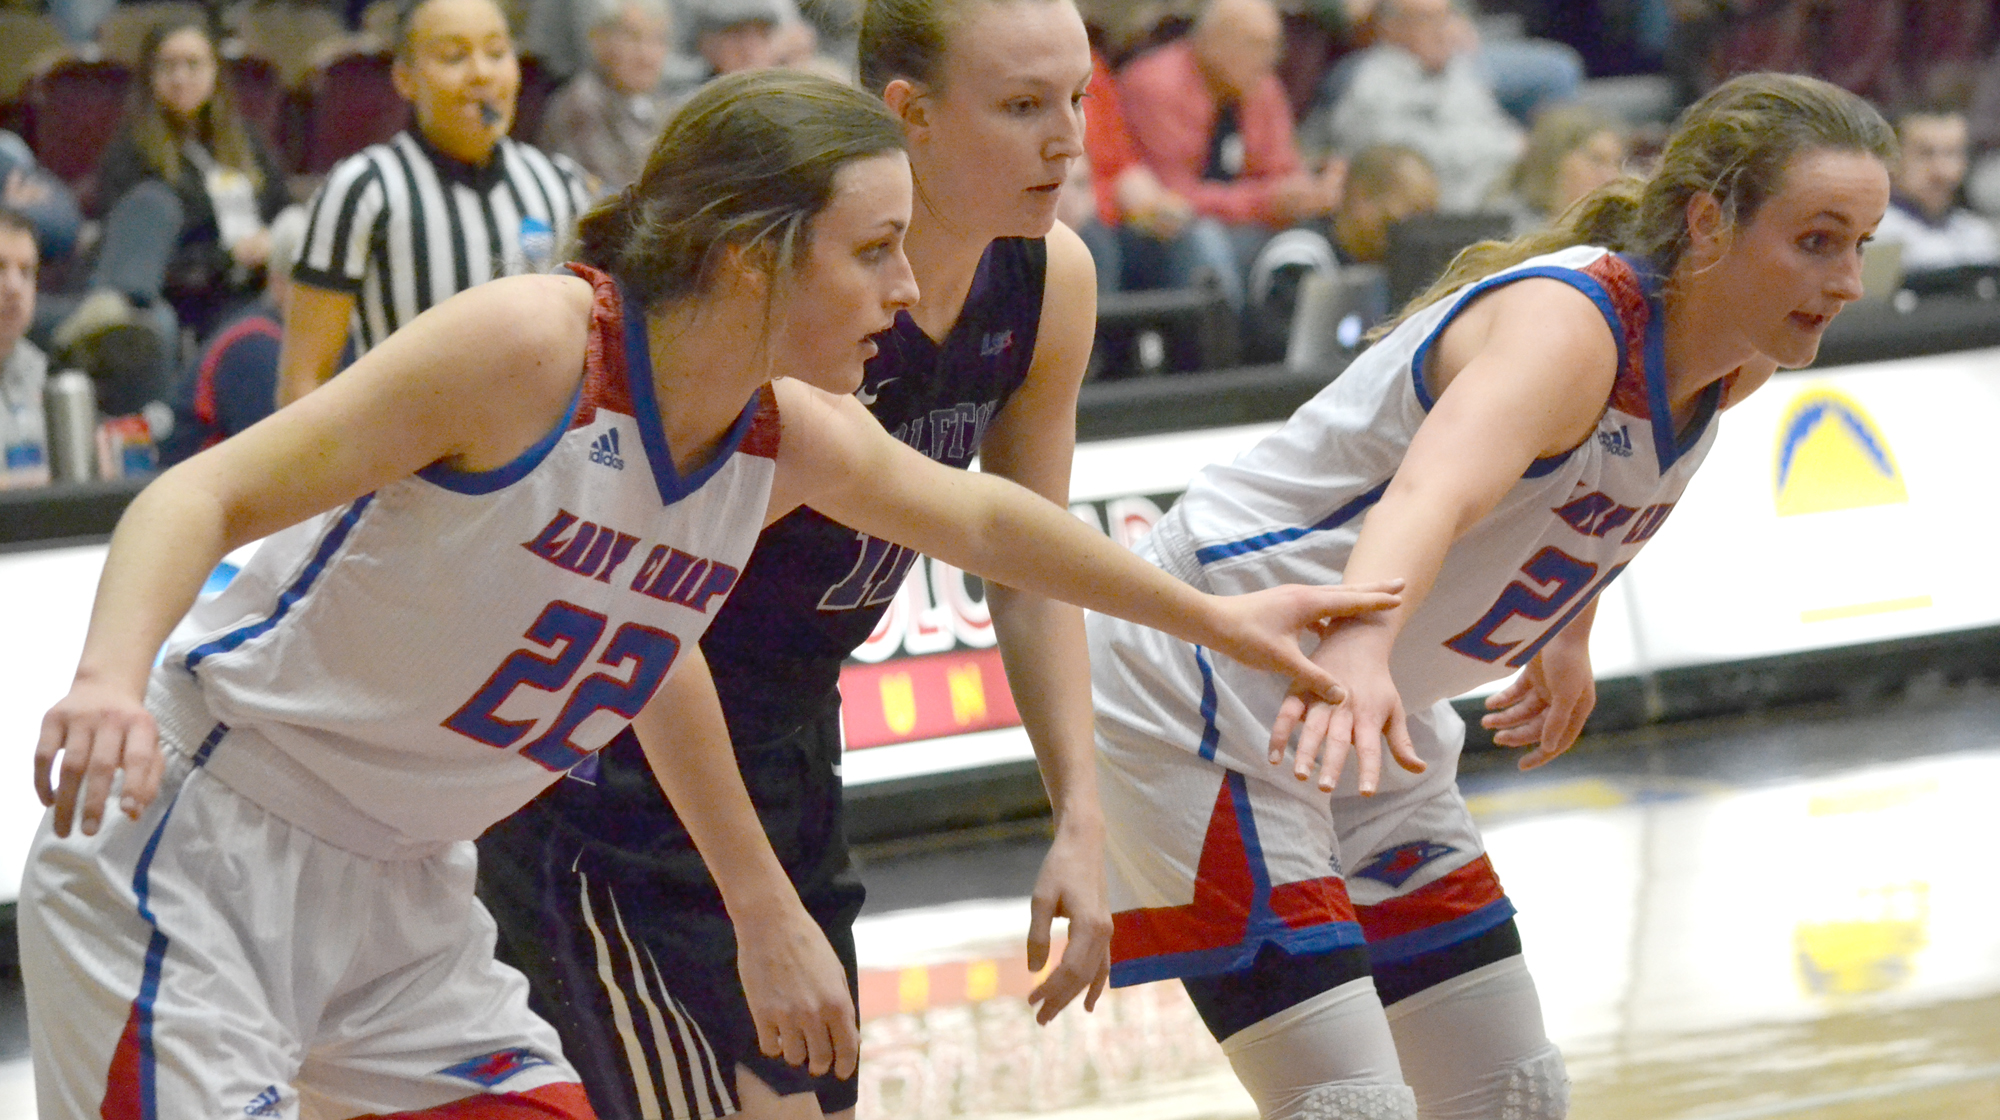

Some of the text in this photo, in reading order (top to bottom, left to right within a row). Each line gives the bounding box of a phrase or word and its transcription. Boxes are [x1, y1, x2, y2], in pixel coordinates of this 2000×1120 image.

[588, 449, 625, 471] adidas
[519, 507, 642, 584] LADY
[1440, 545, 1632, 668] 2
[439, 599, 681, 772] 22
